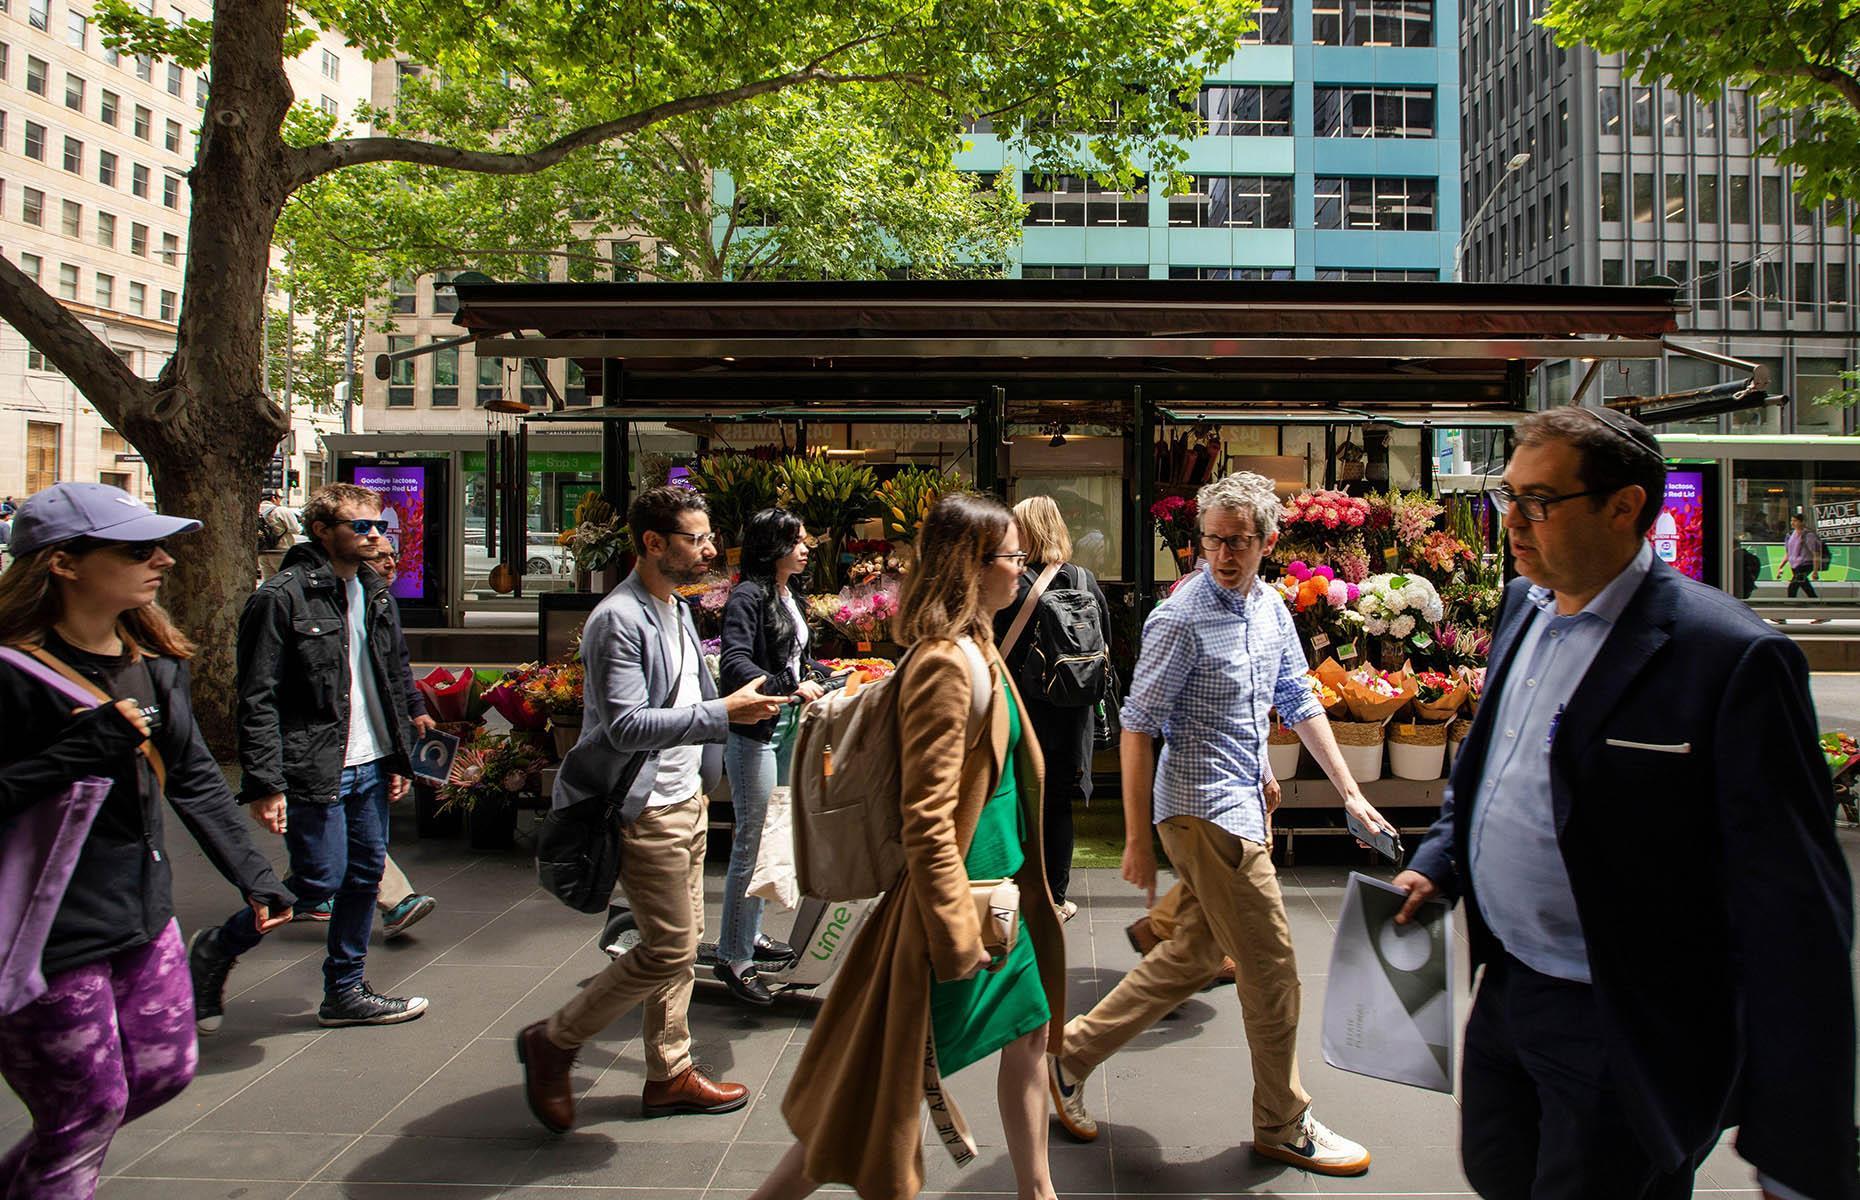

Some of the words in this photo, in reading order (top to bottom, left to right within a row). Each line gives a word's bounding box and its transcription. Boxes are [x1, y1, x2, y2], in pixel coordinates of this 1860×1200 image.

[360, 477, 390, 485] Goodbye
[1815, 503, 1856, 519] MADE
[1817, 516, 1860, 528] MELBOUR
[810, 906, 852, 961] Lime
[923, 1081, 947, 1112] AJE
